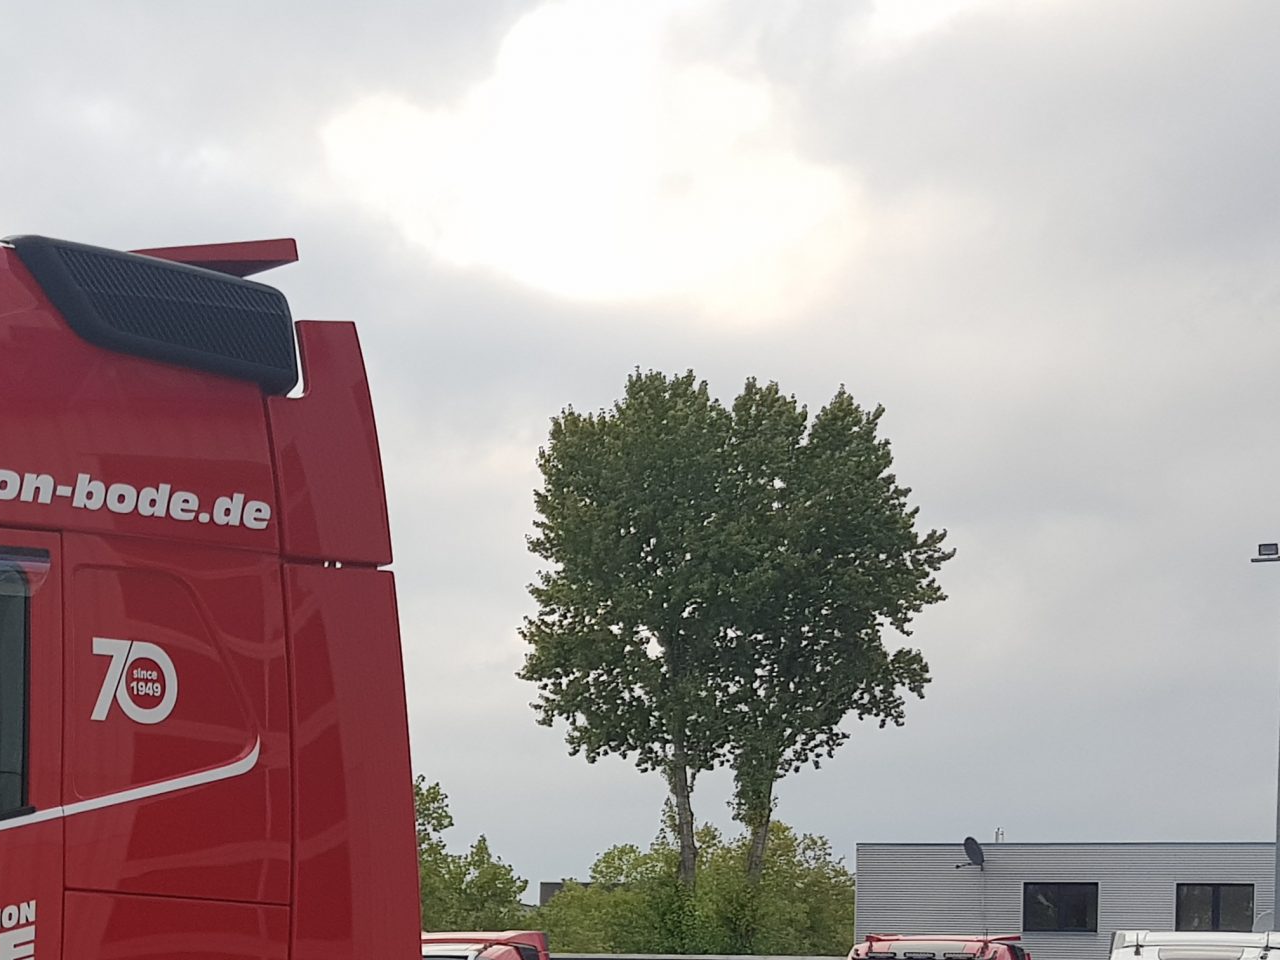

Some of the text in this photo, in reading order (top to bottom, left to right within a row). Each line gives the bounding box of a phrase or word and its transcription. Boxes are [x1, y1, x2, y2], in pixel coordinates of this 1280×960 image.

[90, 636, 179, 725] 70
[132, 667, 158, 680] since
[130, 681, 162, 697] 1949
